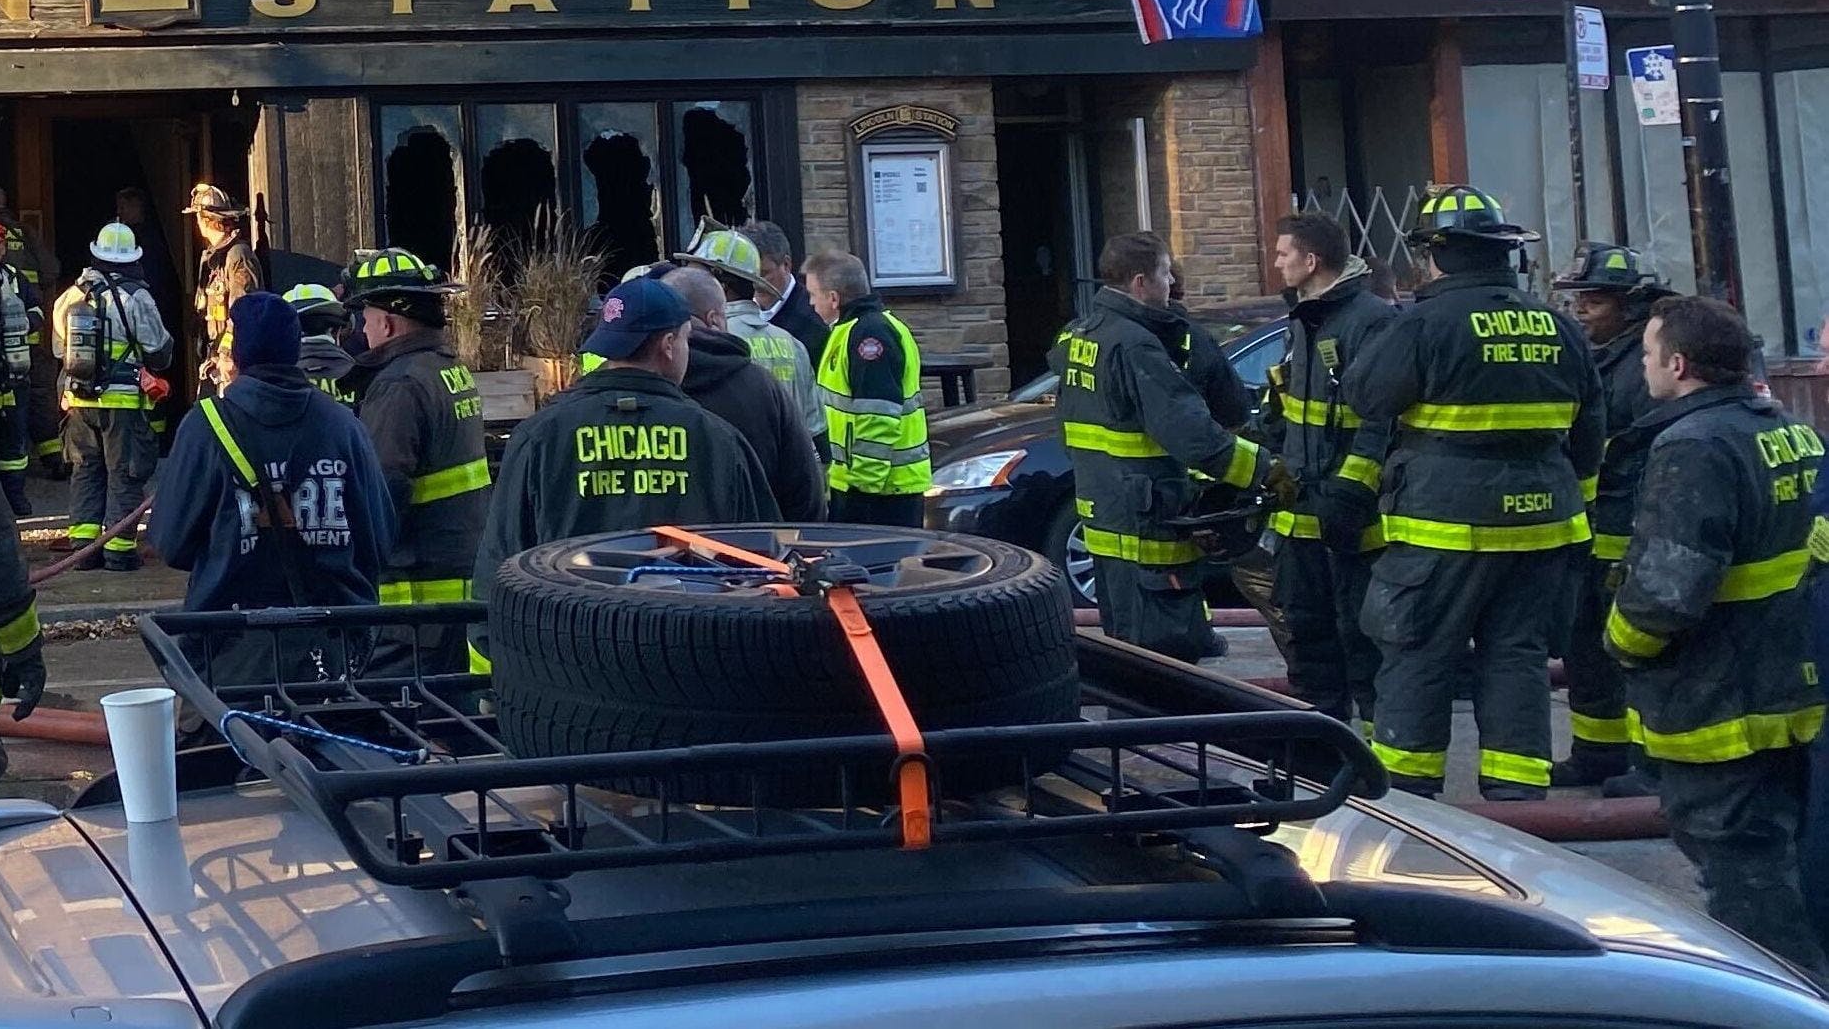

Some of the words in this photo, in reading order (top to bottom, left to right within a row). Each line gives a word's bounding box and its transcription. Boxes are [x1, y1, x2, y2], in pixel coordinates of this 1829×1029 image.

[854, 111, 895, 133] LINCOLN
[914, 110, 955, 130] STATION
[1470, 309, 1558, 338] CHICAGO
[1483, 343, 1519, 363] FIRE
[1520, 343, 1562, 365] DEPT
[576, 424, 688, 463] CHICAGO
[578, 470, 627, 497] FIRE
[633, 469, 690, 495] DEPT
[235, 477, 350, 538] FRE
[1503, 492, 1553, 513] PESCH
